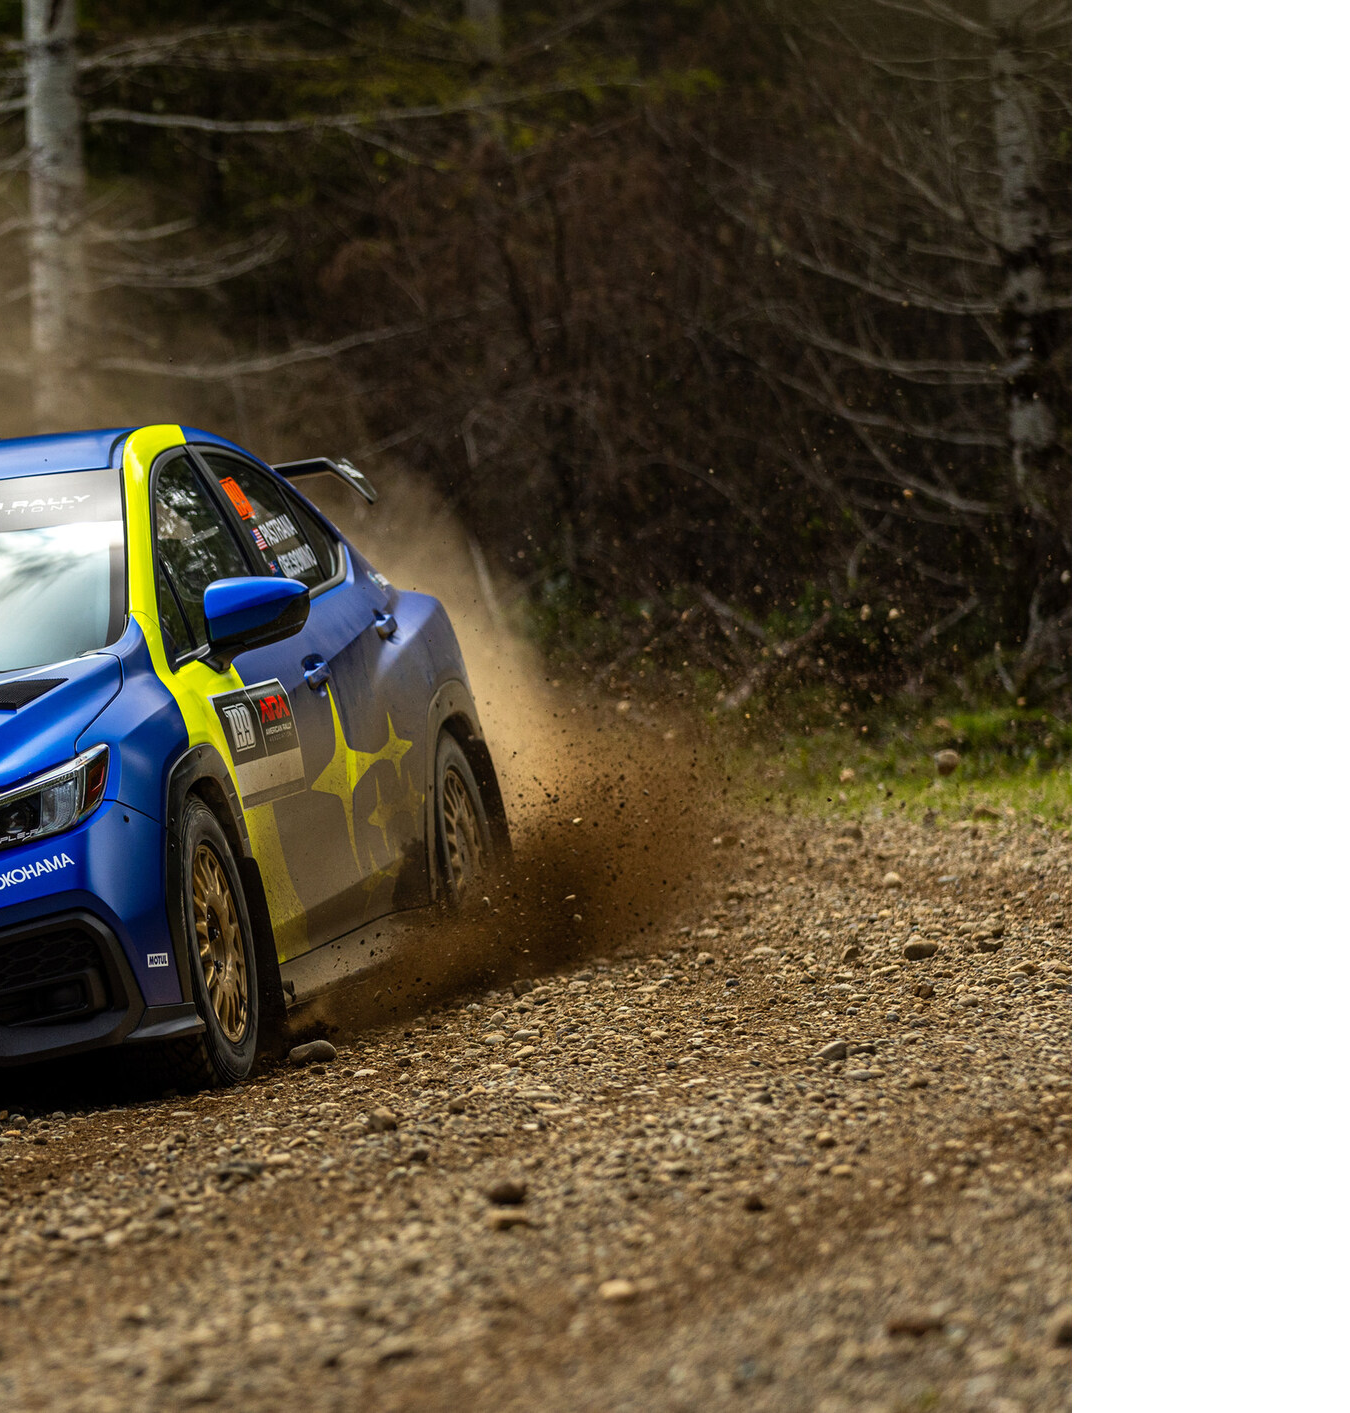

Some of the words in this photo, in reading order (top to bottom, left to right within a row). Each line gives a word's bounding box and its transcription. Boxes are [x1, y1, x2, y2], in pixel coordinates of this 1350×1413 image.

[11, 495, 91, 509] RALLY
[258, 514, 299, 547] PASTRANA
[259, 694, 290, 723] ARA
[222, 703, 256, 752] 199
[149, 955, 167, 965] MOTUL
